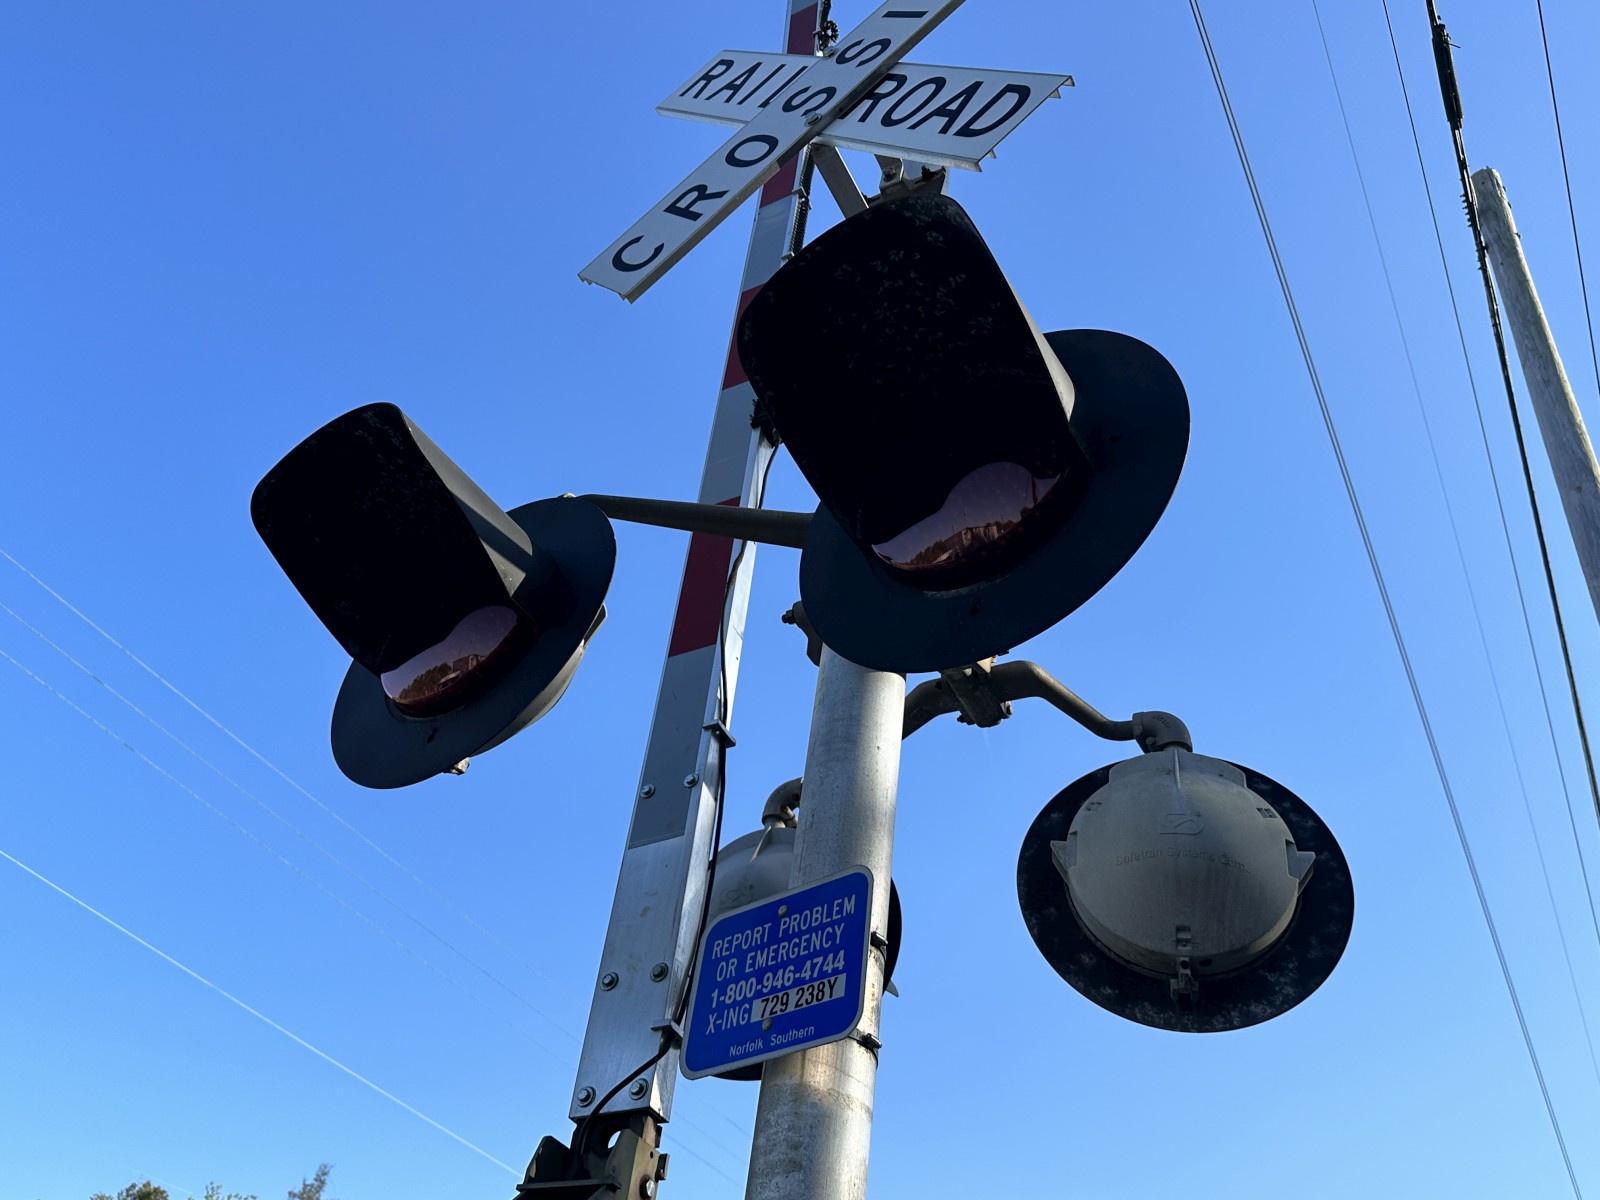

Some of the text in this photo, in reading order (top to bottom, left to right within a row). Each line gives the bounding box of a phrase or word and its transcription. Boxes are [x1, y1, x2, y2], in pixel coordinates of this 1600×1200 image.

[838, 73, 1032, 138] ROAD
[1167, 846, 1215, 862] Systems
[711, 894, 856, 960] REPORT PROBLEM
[716, 923, 845, 982] OR EMERGENCY
[705, 976, 839, 1036] X-ING 729 238Y
[710, 949, 845, 1008] 1-800-946-4744
[729, 1025, 815, 1058] Norfolk Southern
